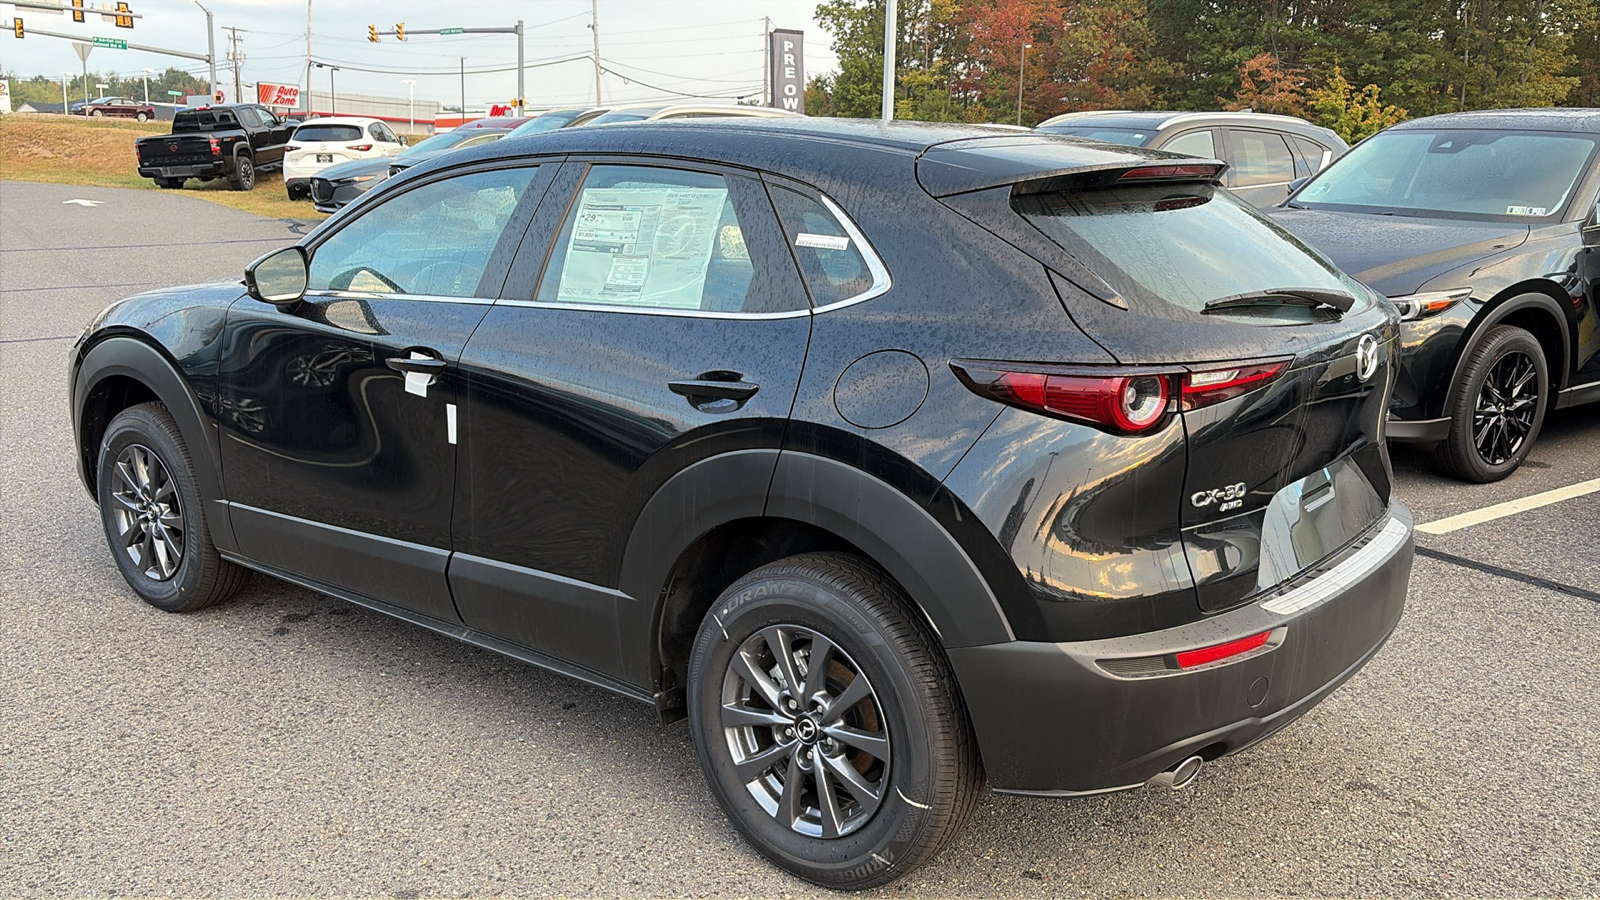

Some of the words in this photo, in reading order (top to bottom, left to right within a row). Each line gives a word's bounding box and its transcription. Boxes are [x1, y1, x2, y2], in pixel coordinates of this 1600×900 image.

[277, 85, 299, 96] Auto
[272, 94, 296, 106] Zone
[782, 83, 799, 114] OW
[585, 213, 597, 222] 29
[1190, 482, 1247, 508] CX-30
